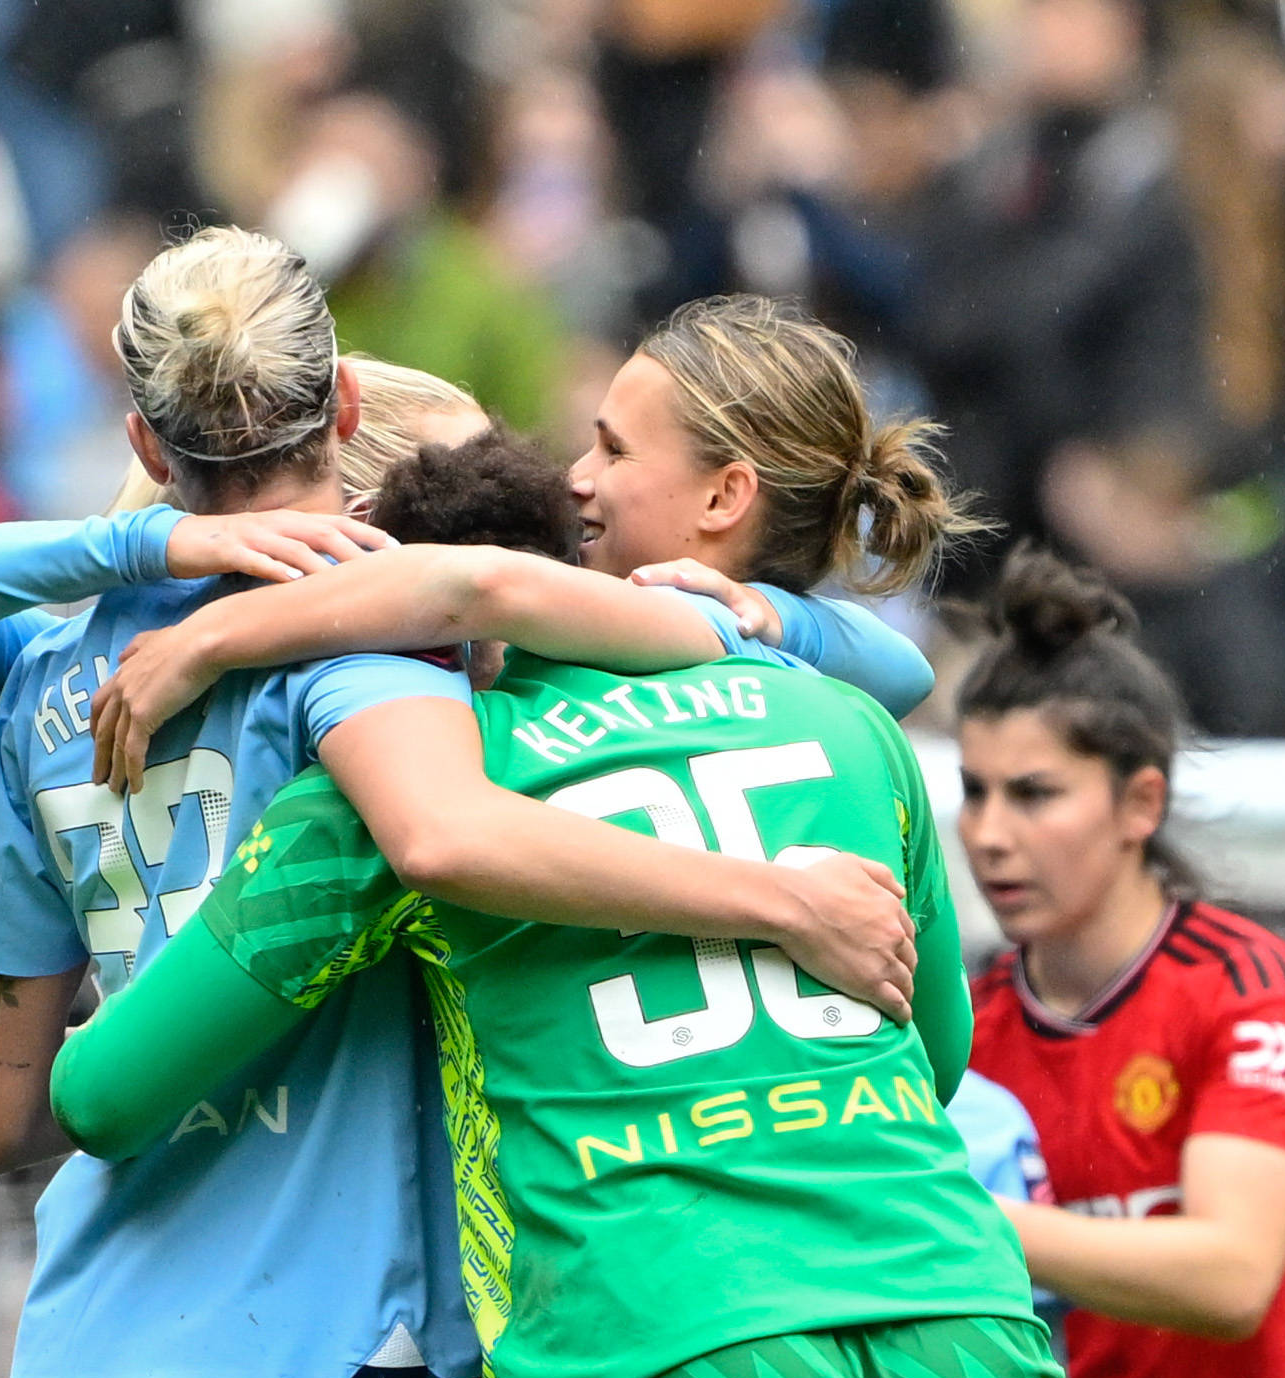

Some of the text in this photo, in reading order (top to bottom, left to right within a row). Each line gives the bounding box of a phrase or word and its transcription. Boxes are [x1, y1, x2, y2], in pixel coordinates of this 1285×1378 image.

[512, 675, 767, 764] KEATING
[542, 740, 882, 1068] 35
[575, 1076, 938, 1180] NISSAN
